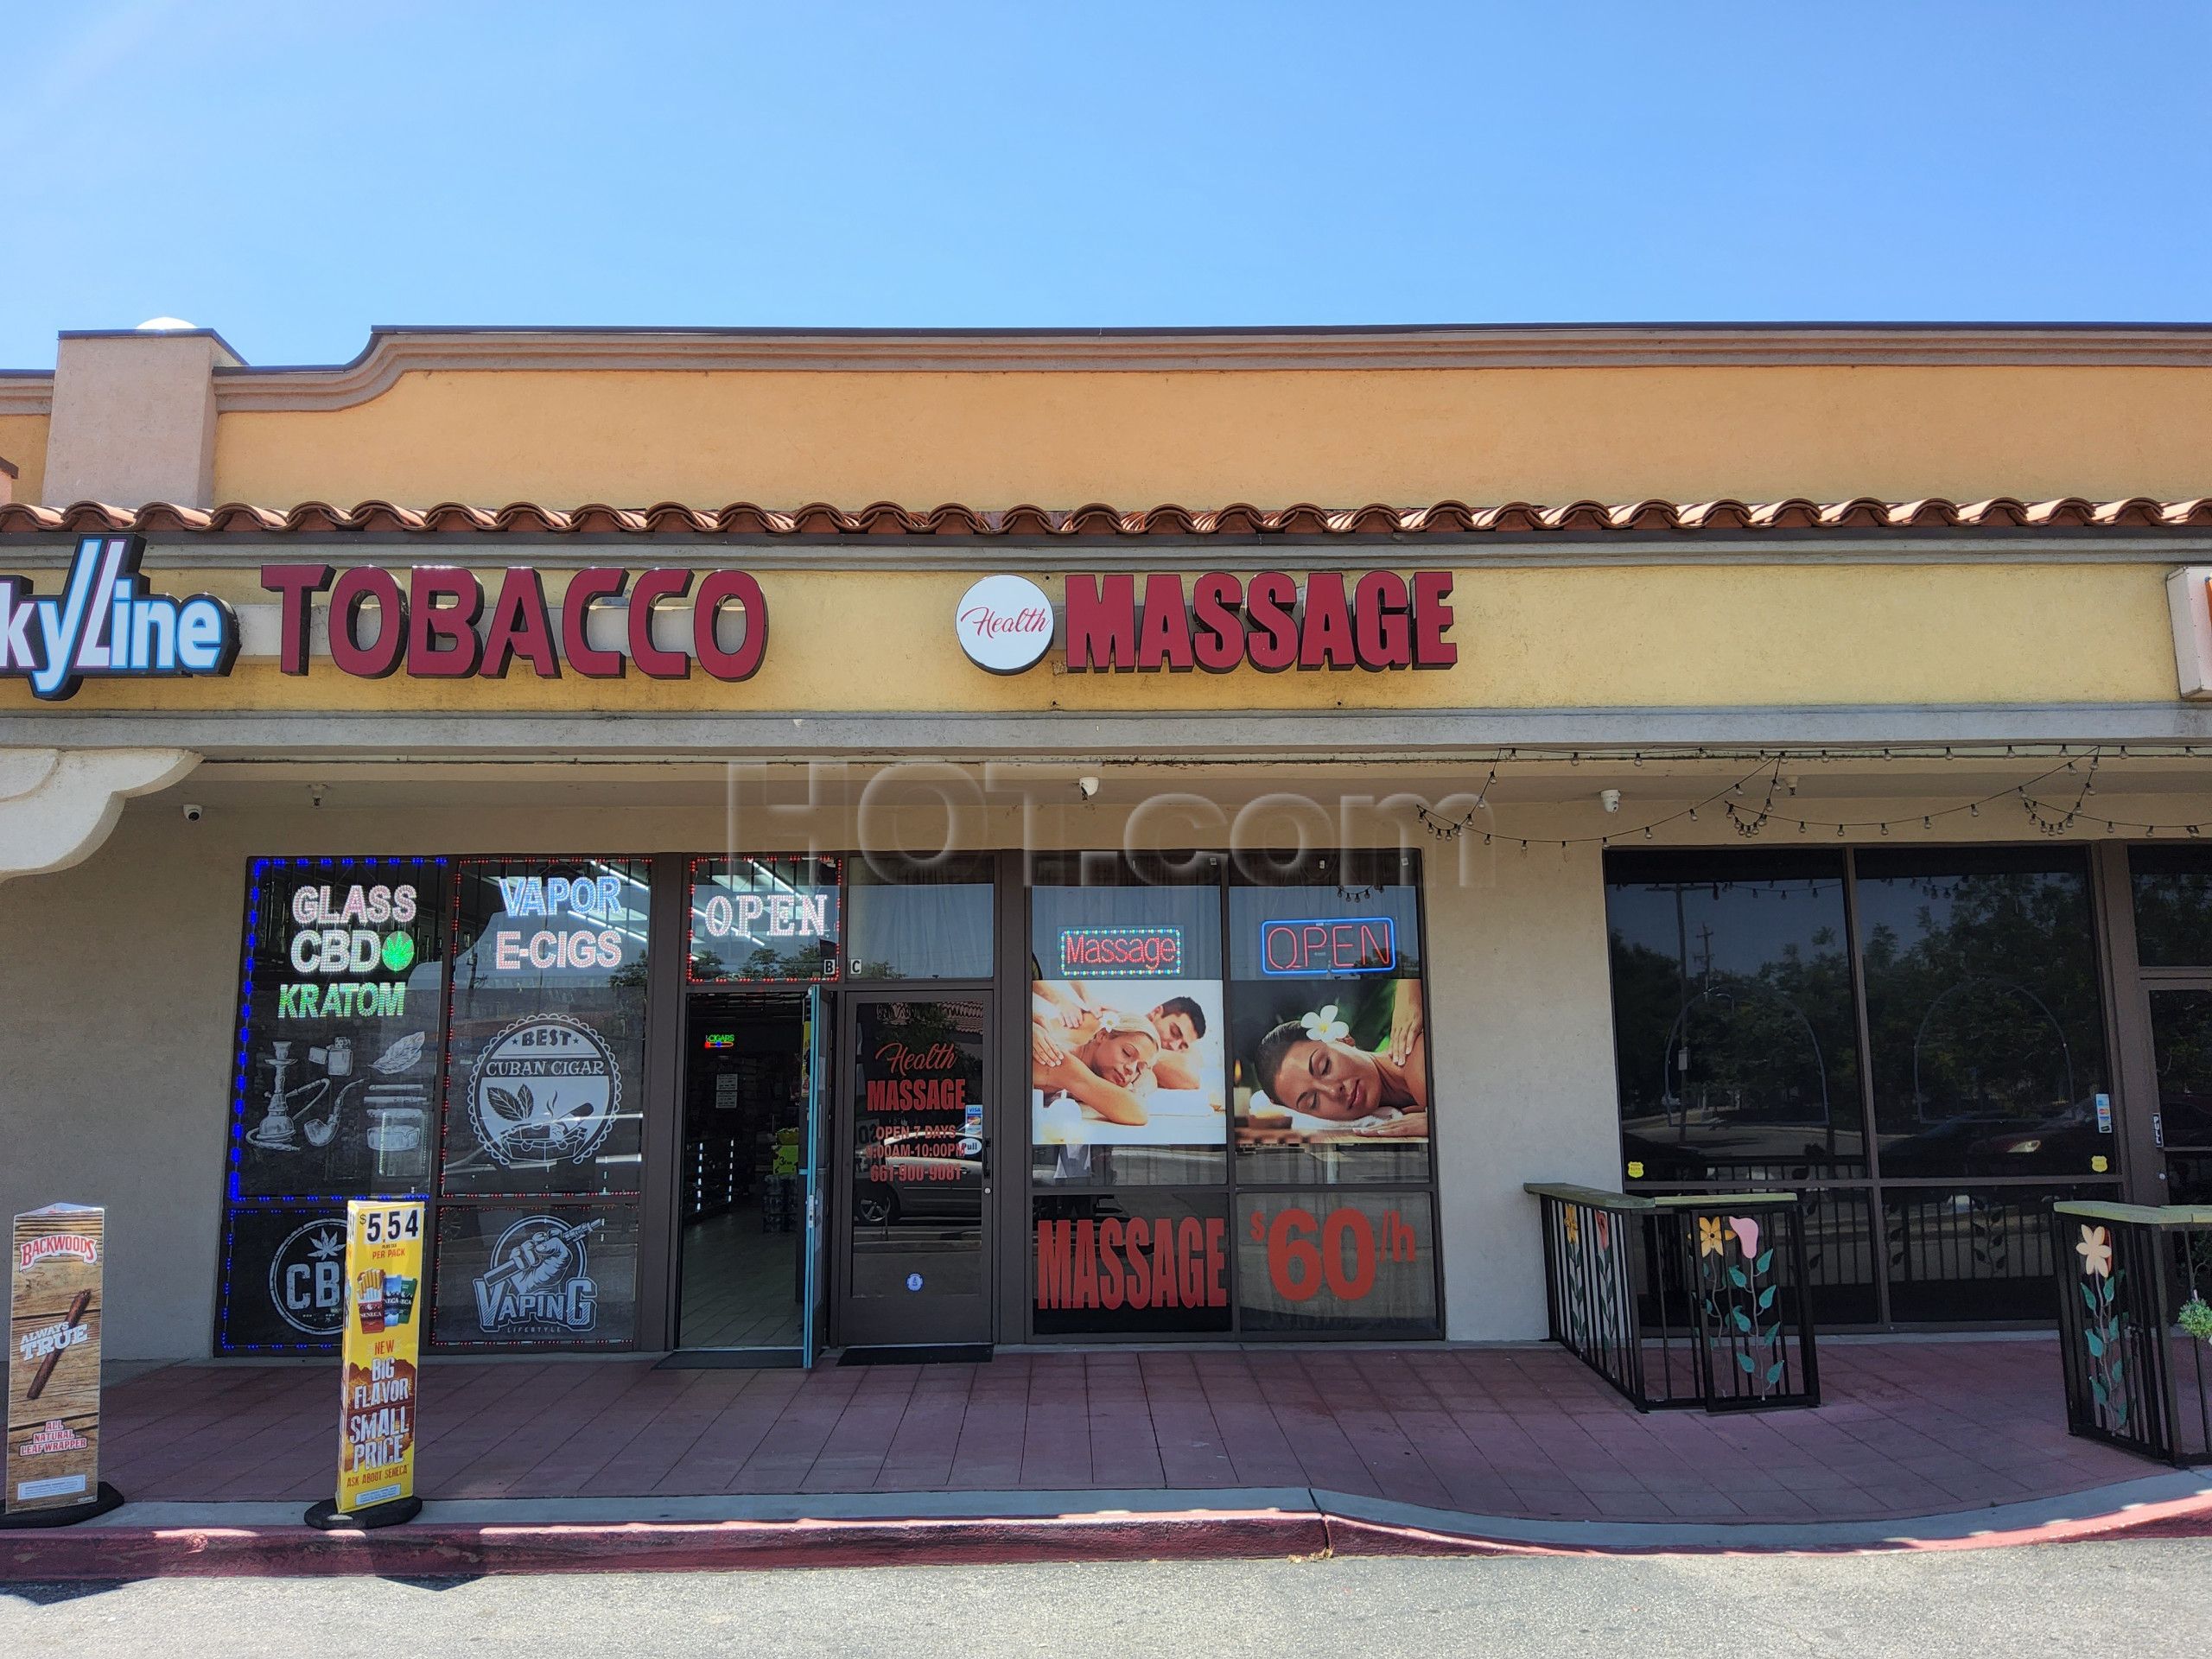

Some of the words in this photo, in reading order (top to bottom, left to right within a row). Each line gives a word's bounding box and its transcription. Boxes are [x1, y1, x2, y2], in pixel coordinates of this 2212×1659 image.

[261, 563, 767, 680] TOBACCO
[960, 607, 1051, 638] Health
[1065, 570, 1458, 672] MASSAGE
[292, 885, 416, 924] GLASS
[499, 876, 624, 918] VAPOR
[704, 893, 828, 937] OPEN
[290, 930, 380, 973] CBD
[496, 931, 622, 969] E-CIGS
[1065, 933, 1176, 969] Massage
[1268, 923, 1390, 969] OPEN
[825, 961, 833, 973] B
[852, 961, 860, 973] C
[277, 982, 406, 1019] KRATOM
[522, 1029, 571, 1046] BEST
[486, 1060, 547, 1076] CUBAN
[551, 1060, 604, 1075] CIGAR
[875, 1042, 957, 1076] Health
[867, 1079, 966, 1111] MASSAGE
[876, 1125, 910, 1141] OPEN
[914, 1126, 920, 1139] 7
[925, 1125, 957, 1139] DAYS
[22, 1236, 96, 1267] BACKWOODS
[372, 1250, 385, 1259] PER
[388, 1249, 405, 1257] PACK
[1038, 1217, 1228, 1310] MASSAGE
[286, 1261, 340, 1310] CB
[473, 1277, 597, 1332] VAPING
[21, 1324, 88, 1361] TRUE
[22, 1322, 69, 1344] ALWAYS
[375, 1340, 394, 1355] NEW
[372, 1357, 395, 1382] BIG
[354, 1378, 409, 1409] FLAVOR
[35, 1431, 73, 1441] NATURAL
[46, 1421, 62, 1431] ALL
[349, 1406, 410, 1444] SMALL
[22, 1446, 42, 1455] LEAF
[44, 1439, 86, 1452] WRAPPER
[353, 1434, 404, 1472] PRICE
[347, 1476, 359, 1487] ASK
[362, 1471, 381, 1484] ABOUT
[385, 1465, 407, 1478] SENECA
